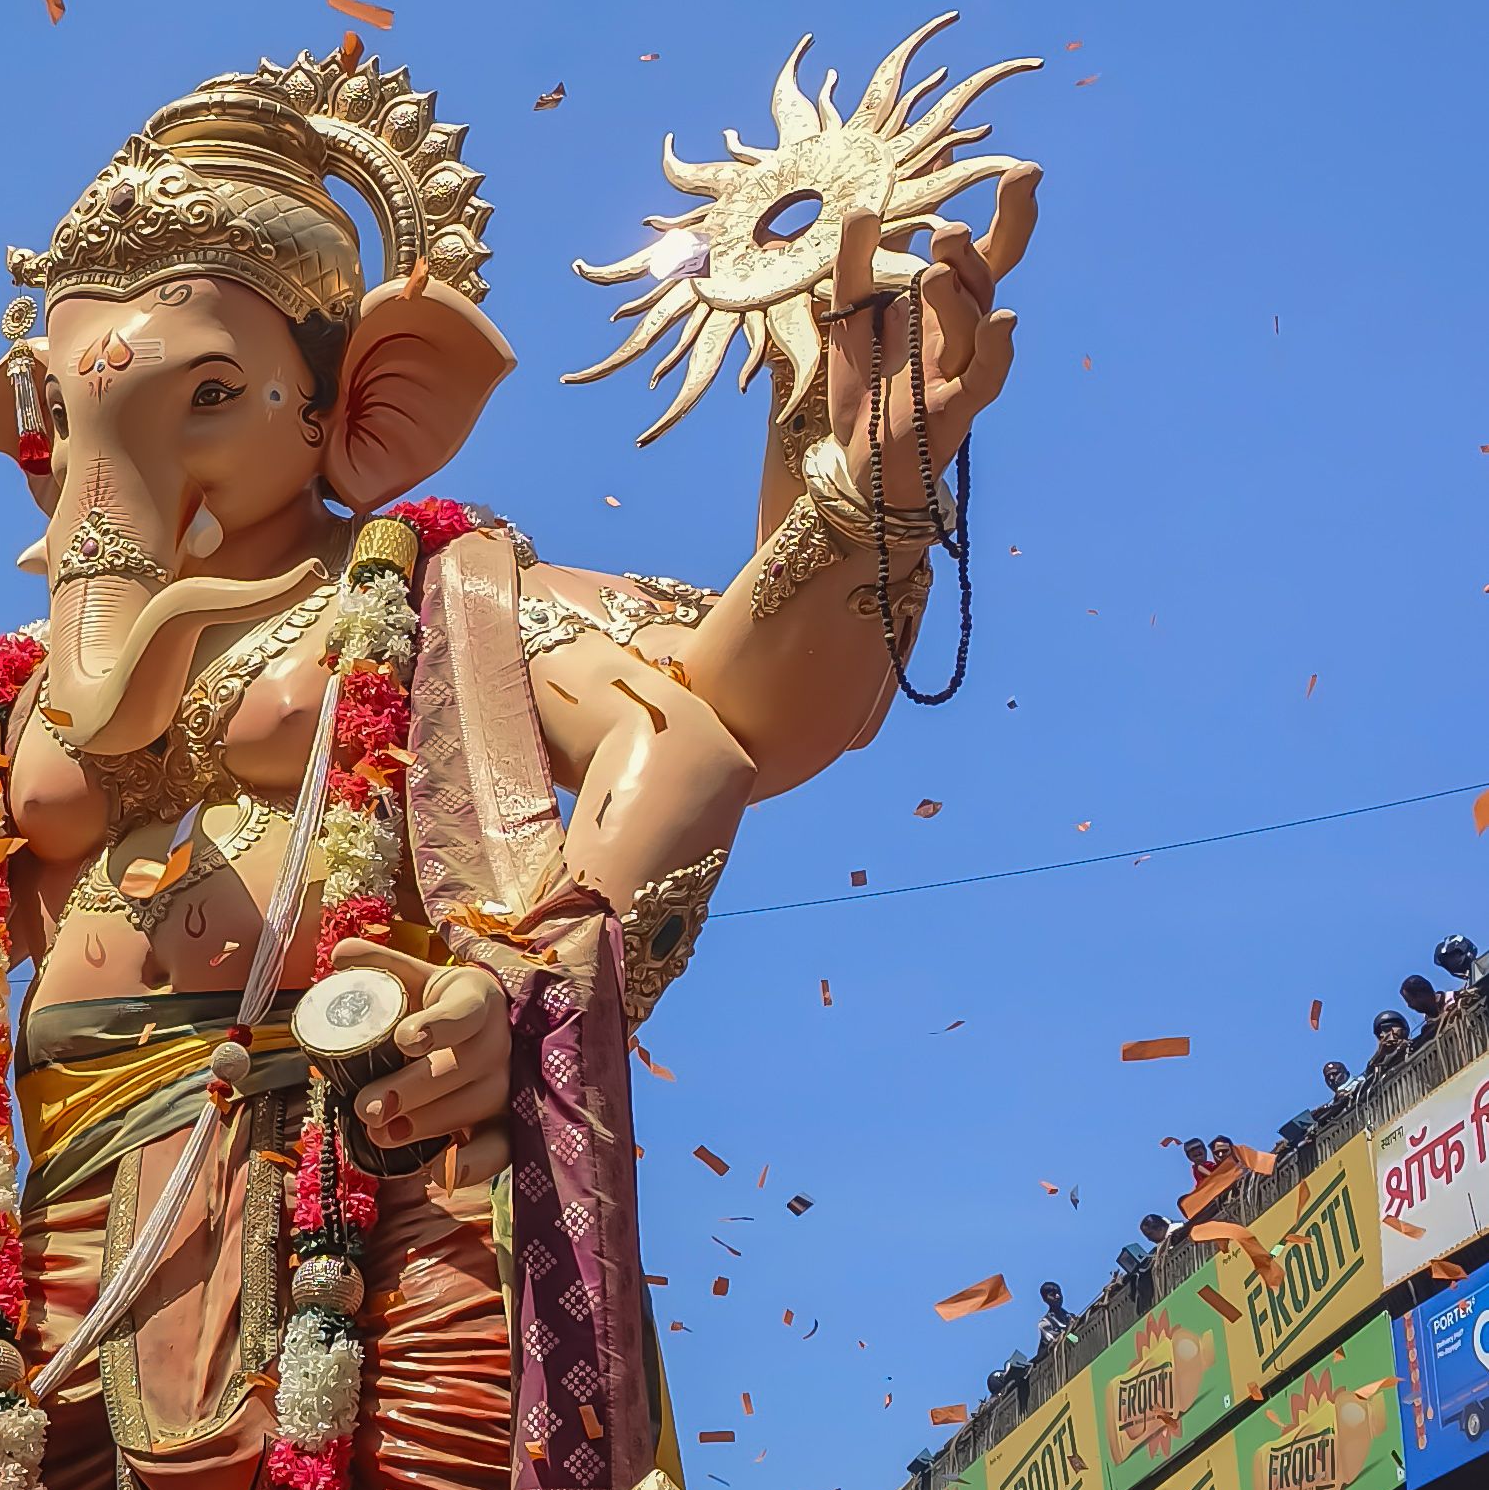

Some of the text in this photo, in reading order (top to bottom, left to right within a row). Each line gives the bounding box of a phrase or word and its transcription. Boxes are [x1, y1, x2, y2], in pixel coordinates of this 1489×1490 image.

[1385, 1125, 1465, 1218] श्रॉफ
[1246, 1185, 1360, 1358] FROOTI
[1434, 1299, 1474, 1335] PORTER
[1118, 1370, 1174, 1422] FROOTI
